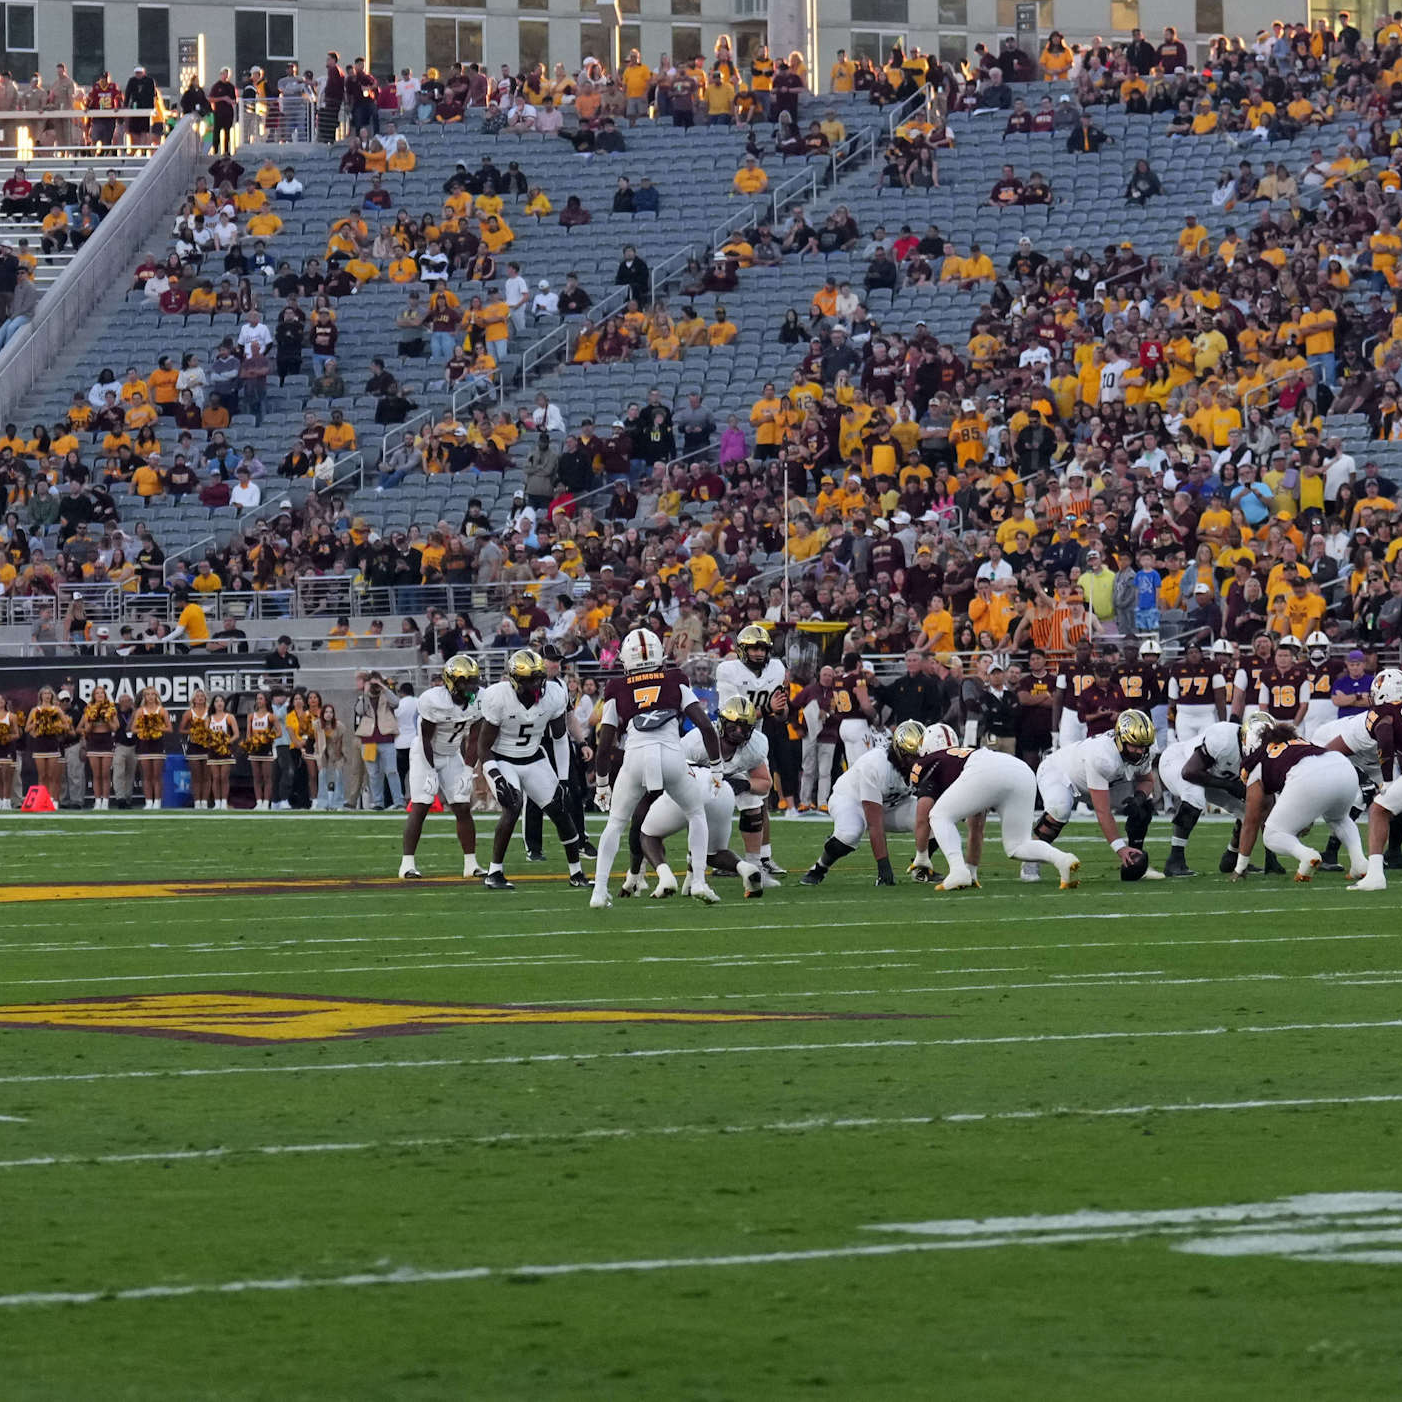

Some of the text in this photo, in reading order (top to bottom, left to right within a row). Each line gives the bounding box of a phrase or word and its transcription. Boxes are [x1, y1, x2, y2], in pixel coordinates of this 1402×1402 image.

[1103, 373, 1116, 388] 10
[961, 427, 980, 442] 85
[626, 672, 665, 685] SIMMONS
[1120, 676, 1143, 698] 12
[1178, 676, 1209, 697] 77
[79, 676, 205, 704] BRANDED
[633, 686, 662, 709] 7
[448, 721, 467, 743] 7
[516, 724, 534, 746] 5
